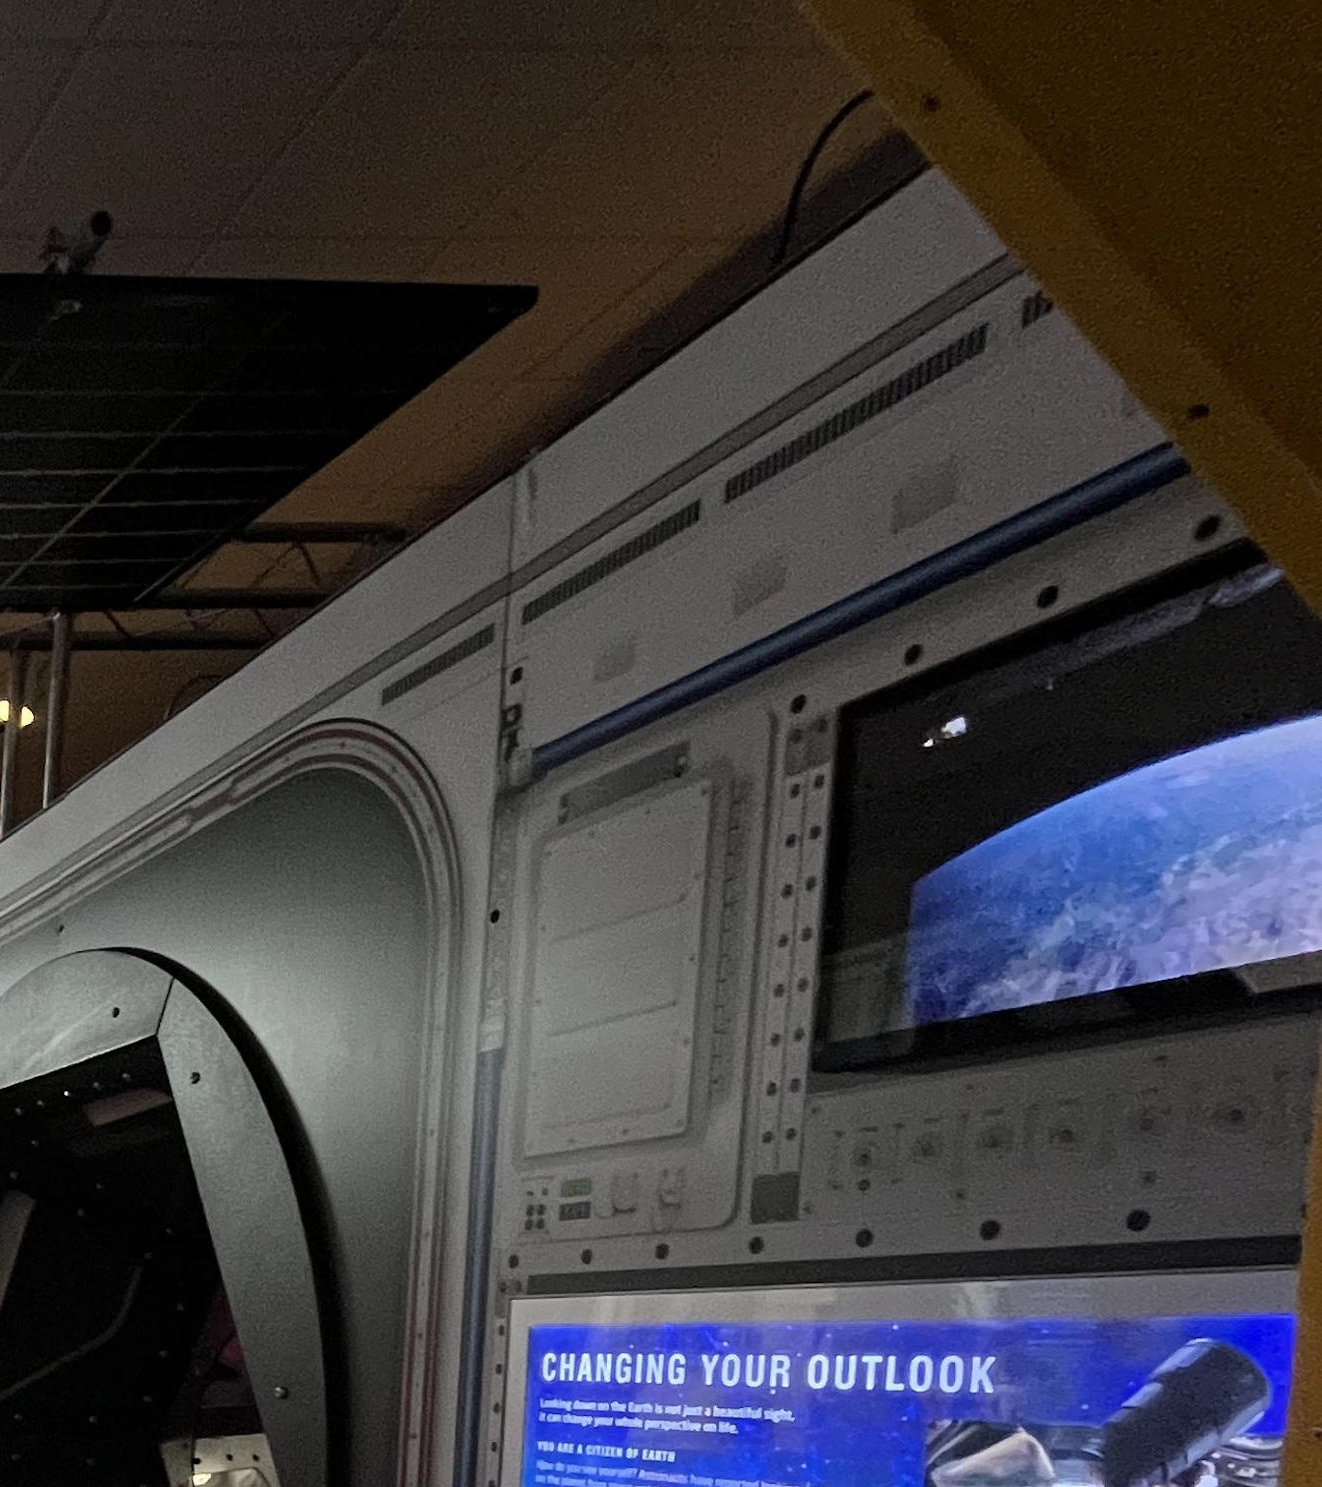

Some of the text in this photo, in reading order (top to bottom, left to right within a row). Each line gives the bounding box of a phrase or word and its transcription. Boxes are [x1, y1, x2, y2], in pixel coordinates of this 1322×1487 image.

[542, 1352, 997, 1393] CHANGING YOUR OUTLOOK
[539, 1398, 572, 1411] Looking
[572, 1399, 597, 1411] down
[597, 1401, 609, 1412] on
[610, 1400, 626, 1412] the
[628, 1401, 653, 1413] Earth
[655, 1402, 663, 1414] is
[664, 1403, 681, 1415] not
[683, 1404, 703, 1418] just
[713, 1405, 762, 1419] beautiful
[546, 1413, 561, 1423] can
[562, 1413, 593, 1427] change
[593, 1416, 614, 1428] your
[615, 1417, 643, 1429] whole
[644, 1419, 702, 1432] perspective
[702, 1422, 717, 1433] on
[718, 1420, 739, 1435] life.
[537, 1441, 676, 1463] YOU ARE A CITIZEN OF EARTH
